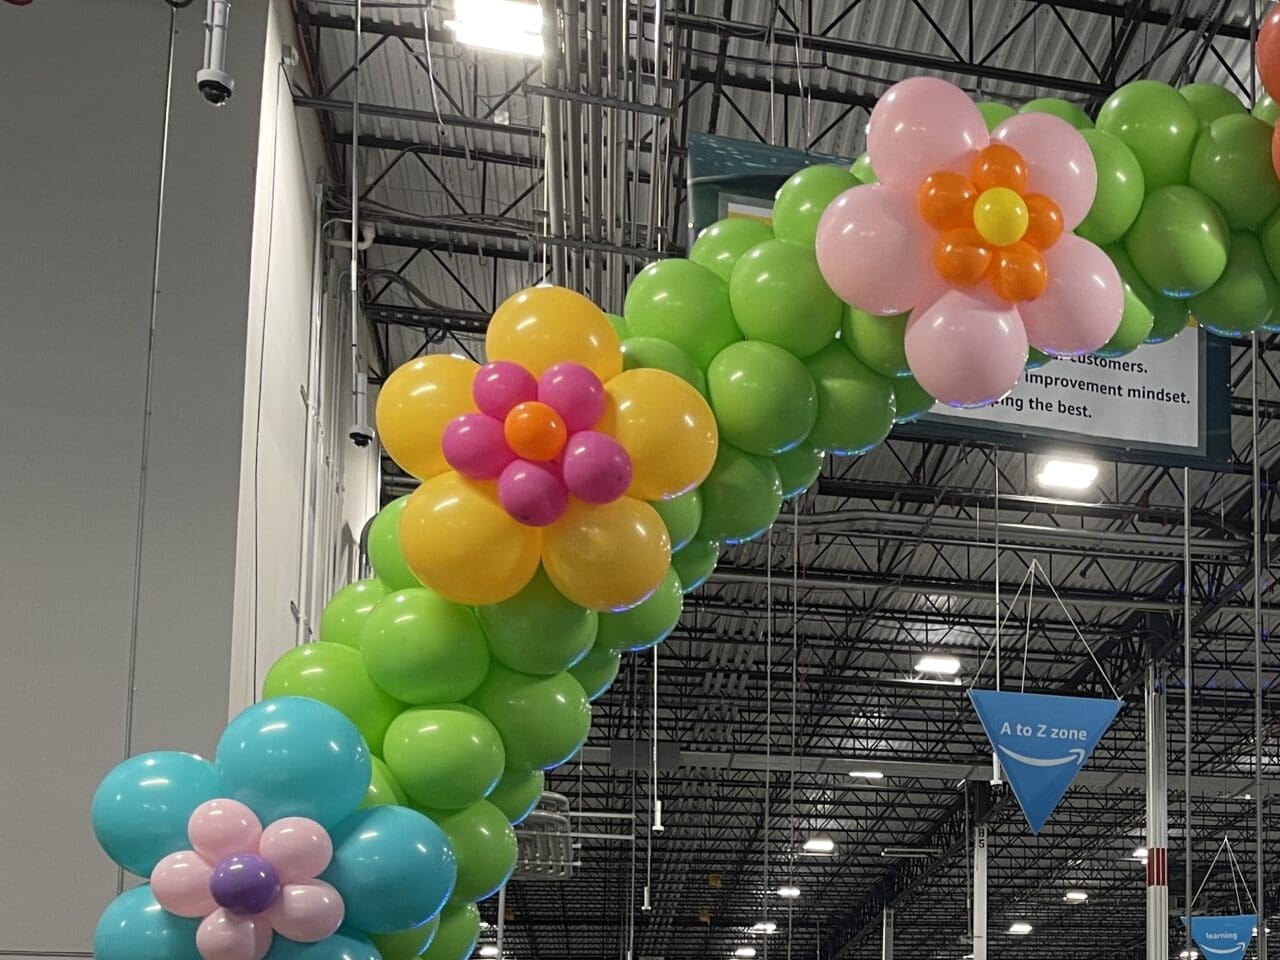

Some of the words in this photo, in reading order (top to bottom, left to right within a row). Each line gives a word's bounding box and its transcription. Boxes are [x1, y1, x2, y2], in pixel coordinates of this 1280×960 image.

[1025, 370, 1123, 397] improvement
[1127, 386, 1191, 405] mindset.
[1029, 397, 1053, 412] the
[1058, 400, 1092, 418] best.
[1000, 722, 1011, 735] A
[1016, 723, 1032, 737] to
[1037, 725, 1047, 737] Z
[1050, 728, 1088, 741] zone
[1206, 932, 1238, 940] learning
